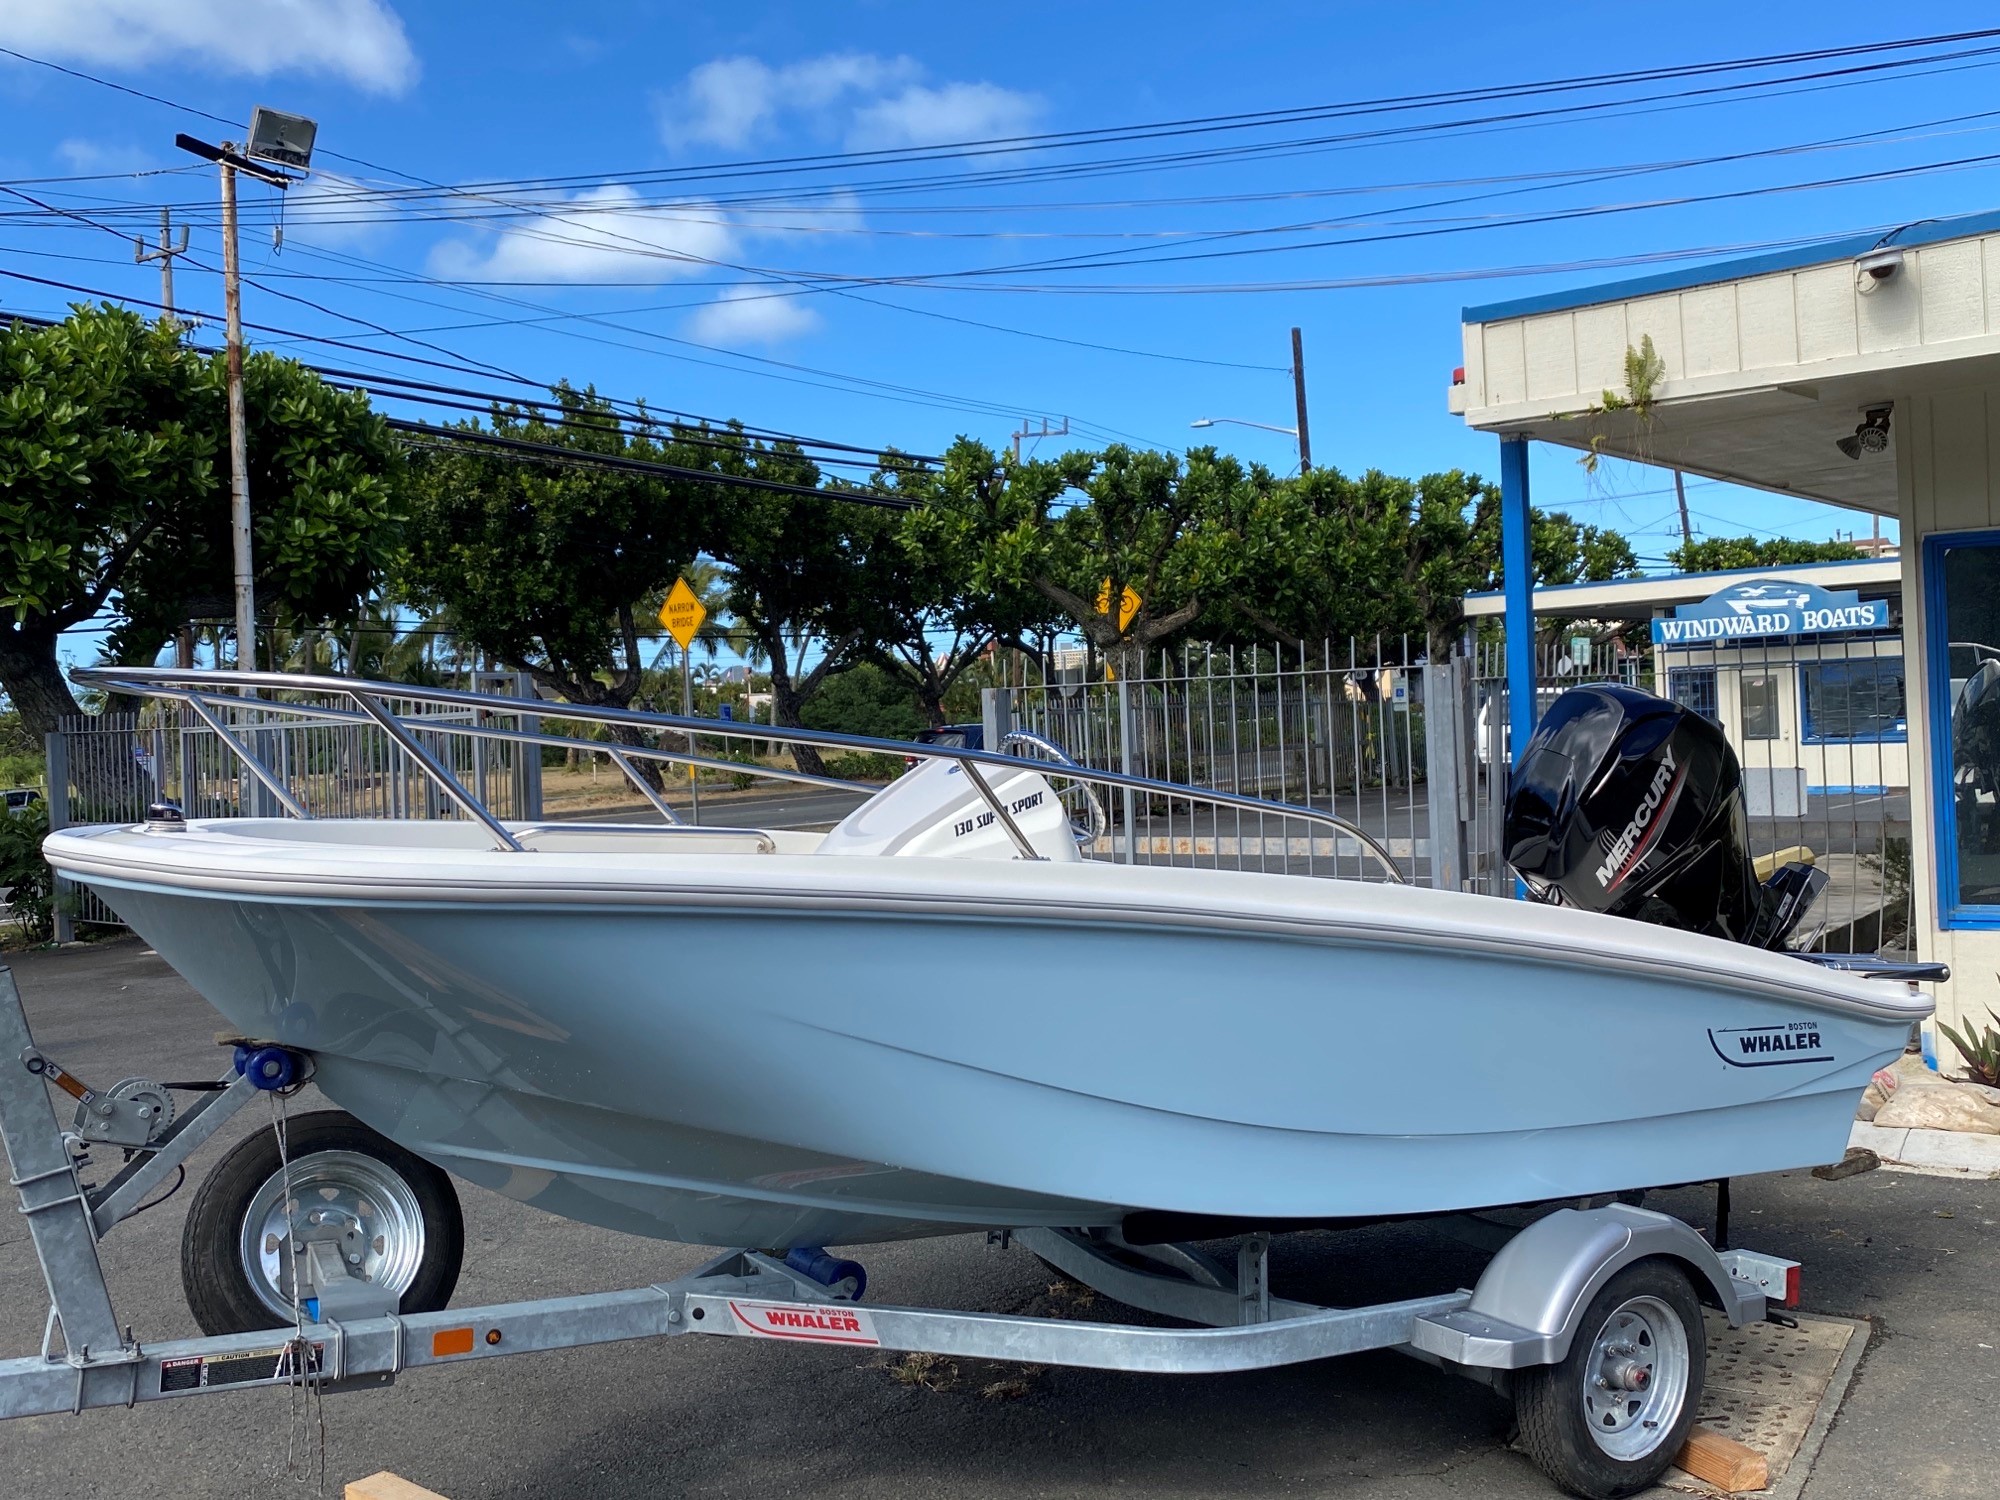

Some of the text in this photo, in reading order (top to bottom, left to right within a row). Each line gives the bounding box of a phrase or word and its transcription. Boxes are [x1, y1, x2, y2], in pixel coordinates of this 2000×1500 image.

[669, 603, 695, 615] NARROW
[672, 616, 694, 628] BRIDGE
[1660, 606, 1875, 640] WINDWARD BOATS
[954, 819, 974, 837] 130
[1012, 791, 1043, 814] SPORT
[1595, 744, 1677, 887] MERCURY
[1788, 1022, 1817, 1031] BOSTON
[1740, 1032, 1821, 1053] WHALER
[819, 1308, 854, 1317] BOSTON
[765, 1312, 861, 1332] WHALER
[172, 1359, 199, 1367] DANGER
[221, 1353, 250, 1361] CAUTION
